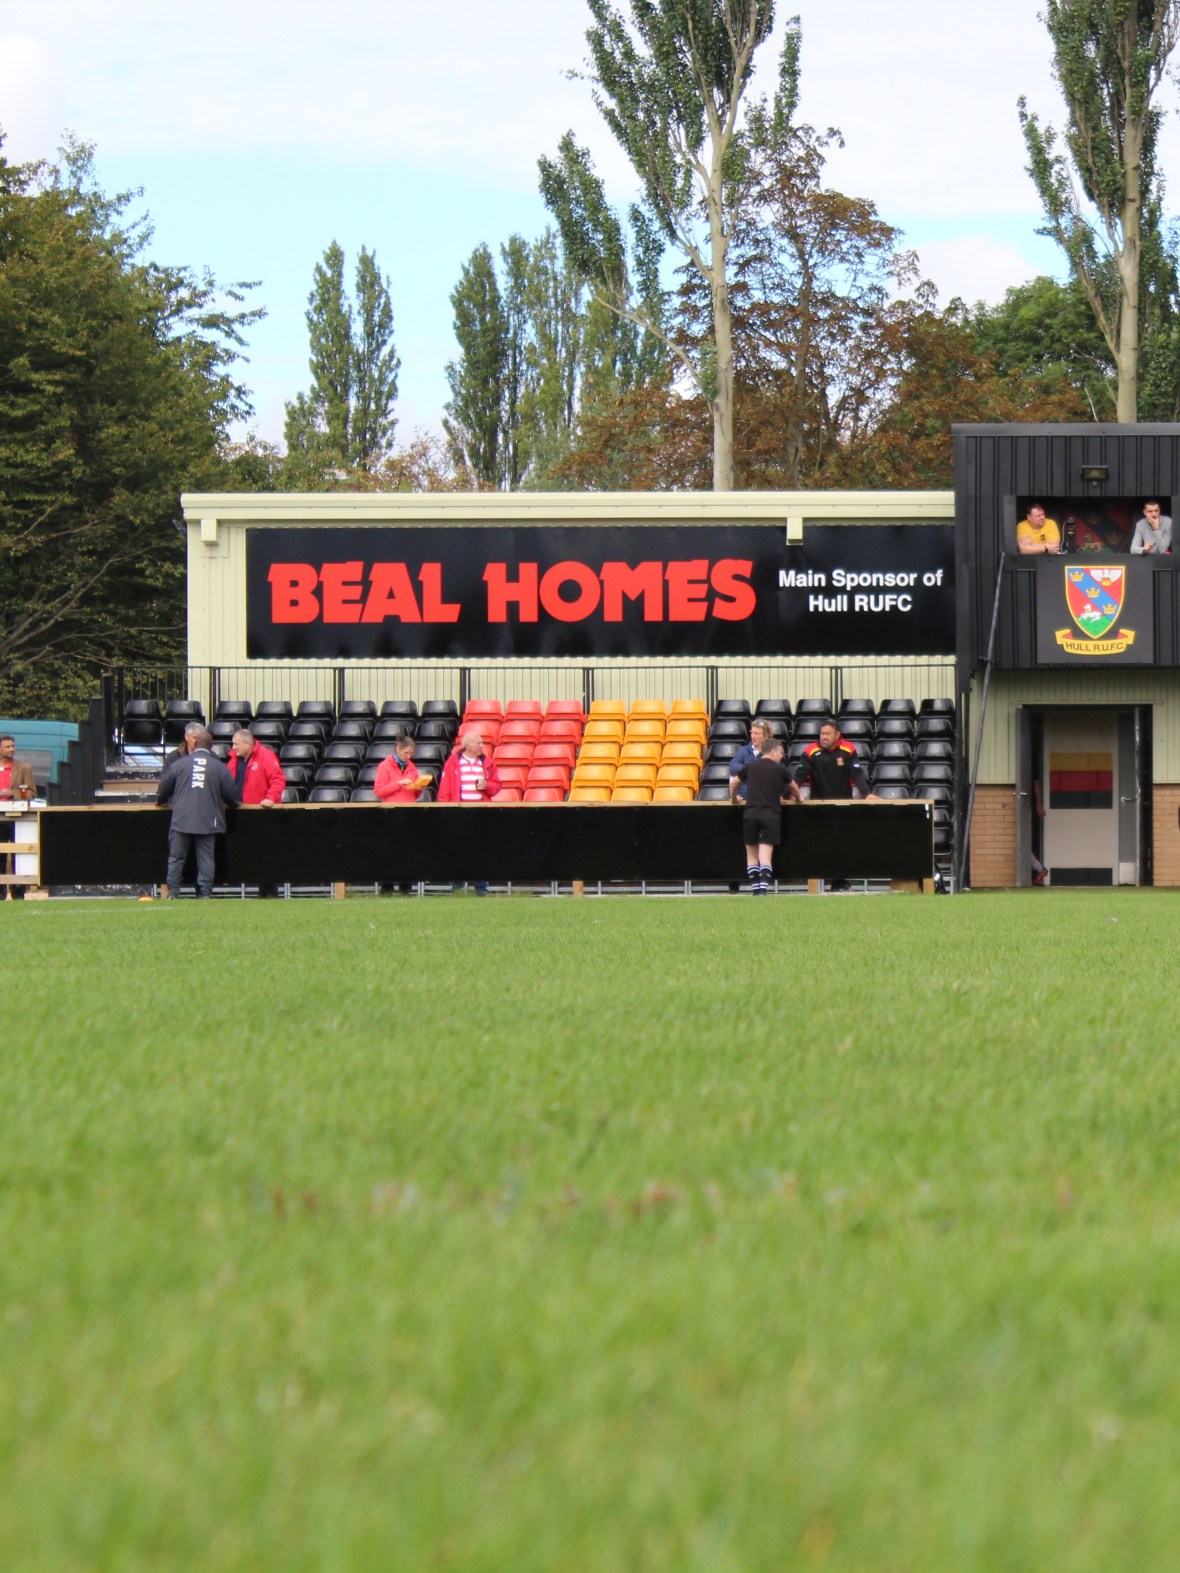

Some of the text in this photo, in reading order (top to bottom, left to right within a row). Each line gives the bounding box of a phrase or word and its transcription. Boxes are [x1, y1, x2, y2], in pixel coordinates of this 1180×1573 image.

[778, 568, 944, 591] Main Sponsor of
[268, 559, 757, 624] BEAL HOMES
[808, 594, 913, 613] Hull RUFC
[1065, 641, 1125, 652] HULL R.U.F.C.
[191, 757, 207, 789] PARK
